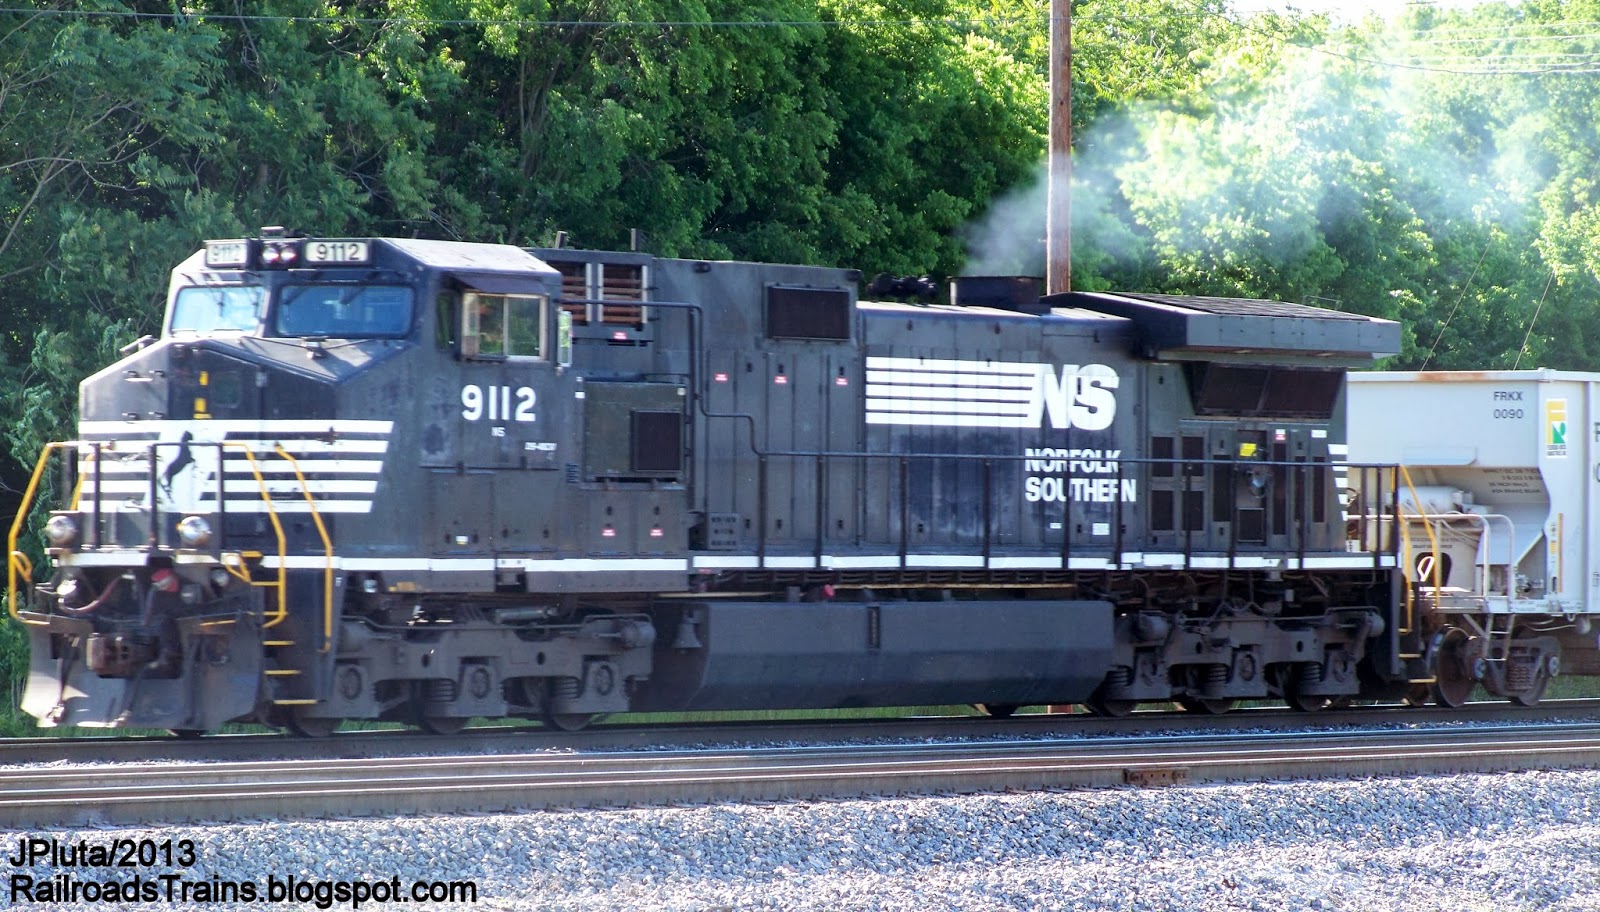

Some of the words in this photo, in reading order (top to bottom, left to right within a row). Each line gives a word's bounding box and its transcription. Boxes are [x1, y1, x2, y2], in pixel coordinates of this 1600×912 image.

[316, 243, 360, 260] 9112
[461, 384, 537, 422] 9112
[1040, 363, 1120, 431] NS
[1493, 391, 1524, 401] FRKX
[1493, 408, 1524, 419] 0090
[491, 426, 506, 437] NS
[1024, 448, 1122, 473] NORFOLK
[1024, 476, 1137, 503] SOUTHERN
